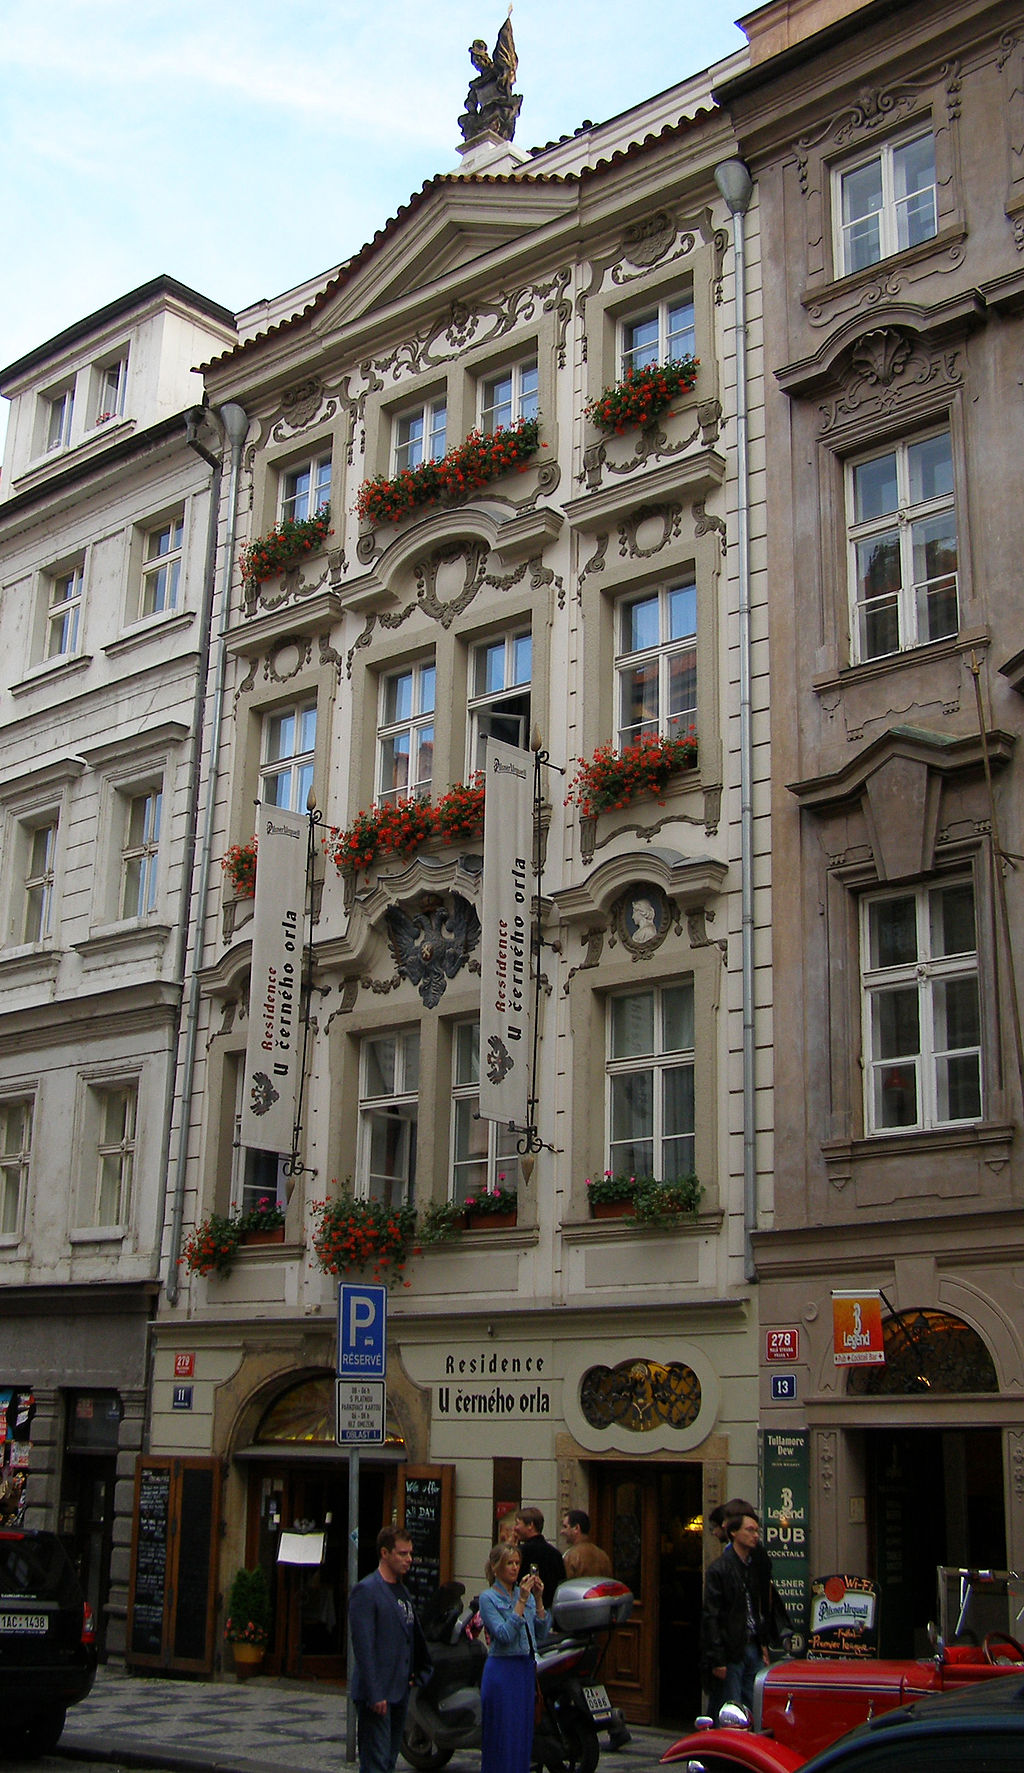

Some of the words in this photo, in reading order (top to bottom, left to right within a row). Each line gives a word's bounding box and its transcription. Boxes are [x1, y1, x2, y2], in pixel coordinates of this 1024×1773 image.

[511, 857, 526, 904] orla
[282, 910, 297, 952] orla
[495, 919, 508, 1013] Residence
[507, 915, 525, 1012] černého
[261, 966, 277, 1051] Residence
[274, 962, 295, 1050] černého
[349, 1296, 376, 1347] P
[771, 1333, 791, 1347] 278
[843, 1329, 871, 1350] Legend
[342, 1352, 382, 1366] RÉSERVÉ
[446, 1353, 544, 1374] Residence
[178, 1389, 185, 1401] 11
[777, 1380, 789, 1394] 13
[439, 1387, 449, 1413] U
[455, 1387, 515, 1413] černého
[519, 1386, 550, 1413] orla
[767, 1435, 804, 1446] Tullamore
[777, 1445, 794, 1456] Dew
[767, 1507, 804, 1520] Legend
[766, 1527, 805, 1543] PUB
[767, 1550, 805, 1558] COCKTAILS
[844, 1574, 874, 1592] Wi-Fi
[2, 1615, 18, 1628] 1AC
[24, 1616, 45, 1628] 1438
